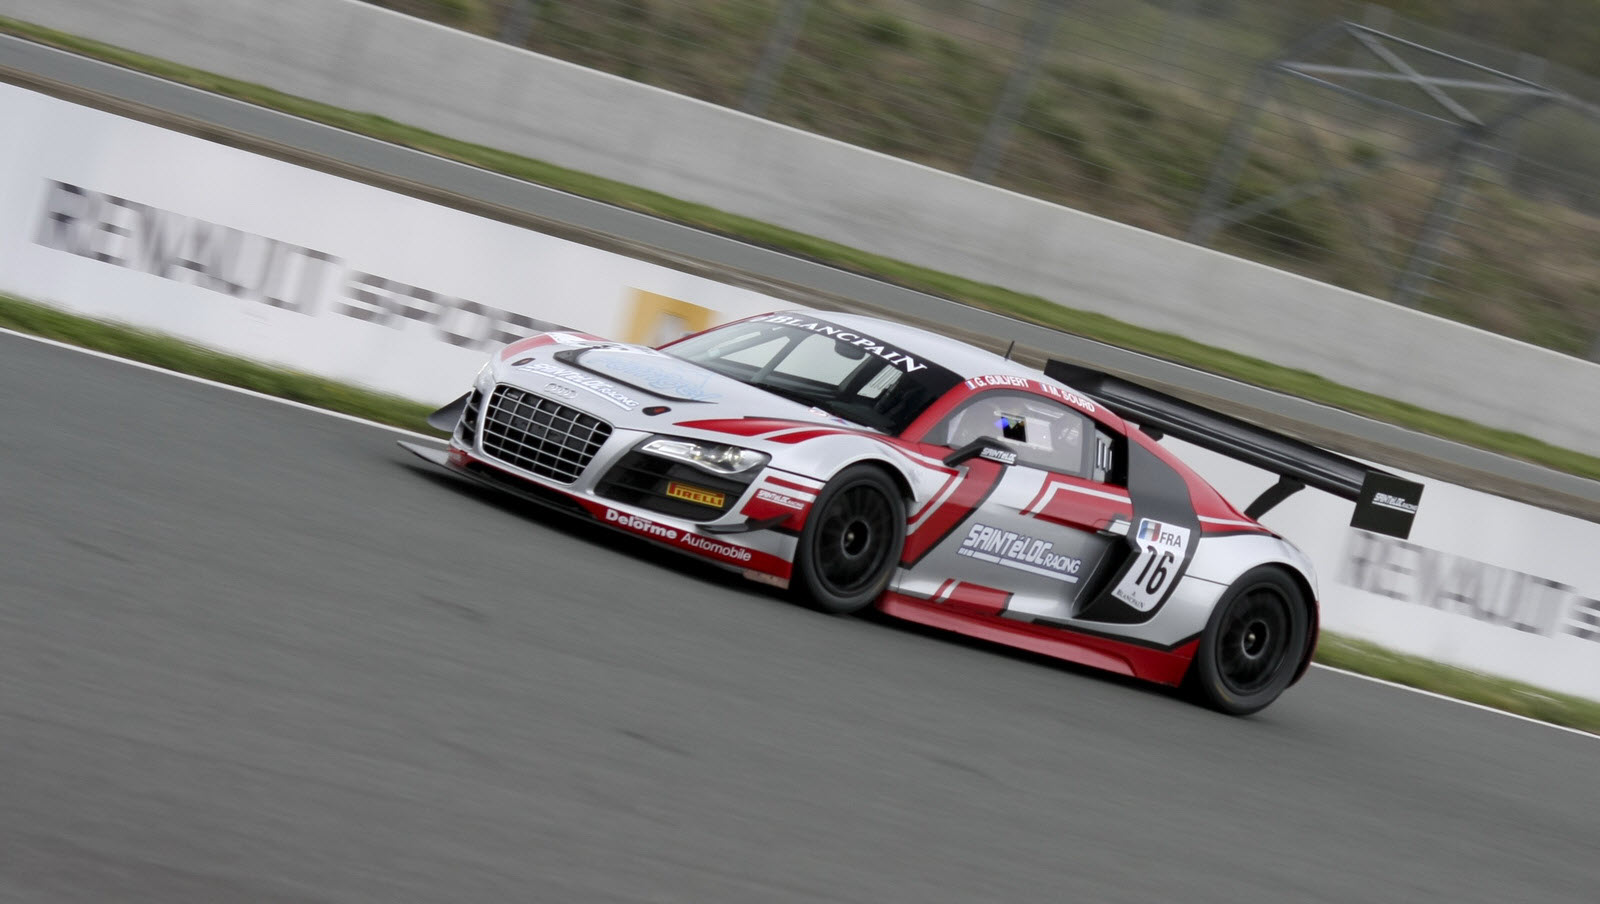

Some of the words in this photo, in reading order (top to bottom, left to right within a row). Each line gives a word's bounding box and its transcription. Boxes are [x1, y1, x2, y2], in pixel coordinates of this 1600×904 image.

[330, 269, 584, 353] SPOR
[765, 314, 928, 373] BLANCPAIN
[1062, 390, 1096, 413] SOURD
[668, 482, 724, 506] PIRELLI
[605, 509, 677, 540] Delorme
[681, 533, 752, 561] Automobile
[1159, 531, 1182, 548] FRA
[1043, 552, 1081, 574] RACING
[1134, 545, 1175, 595] 16
